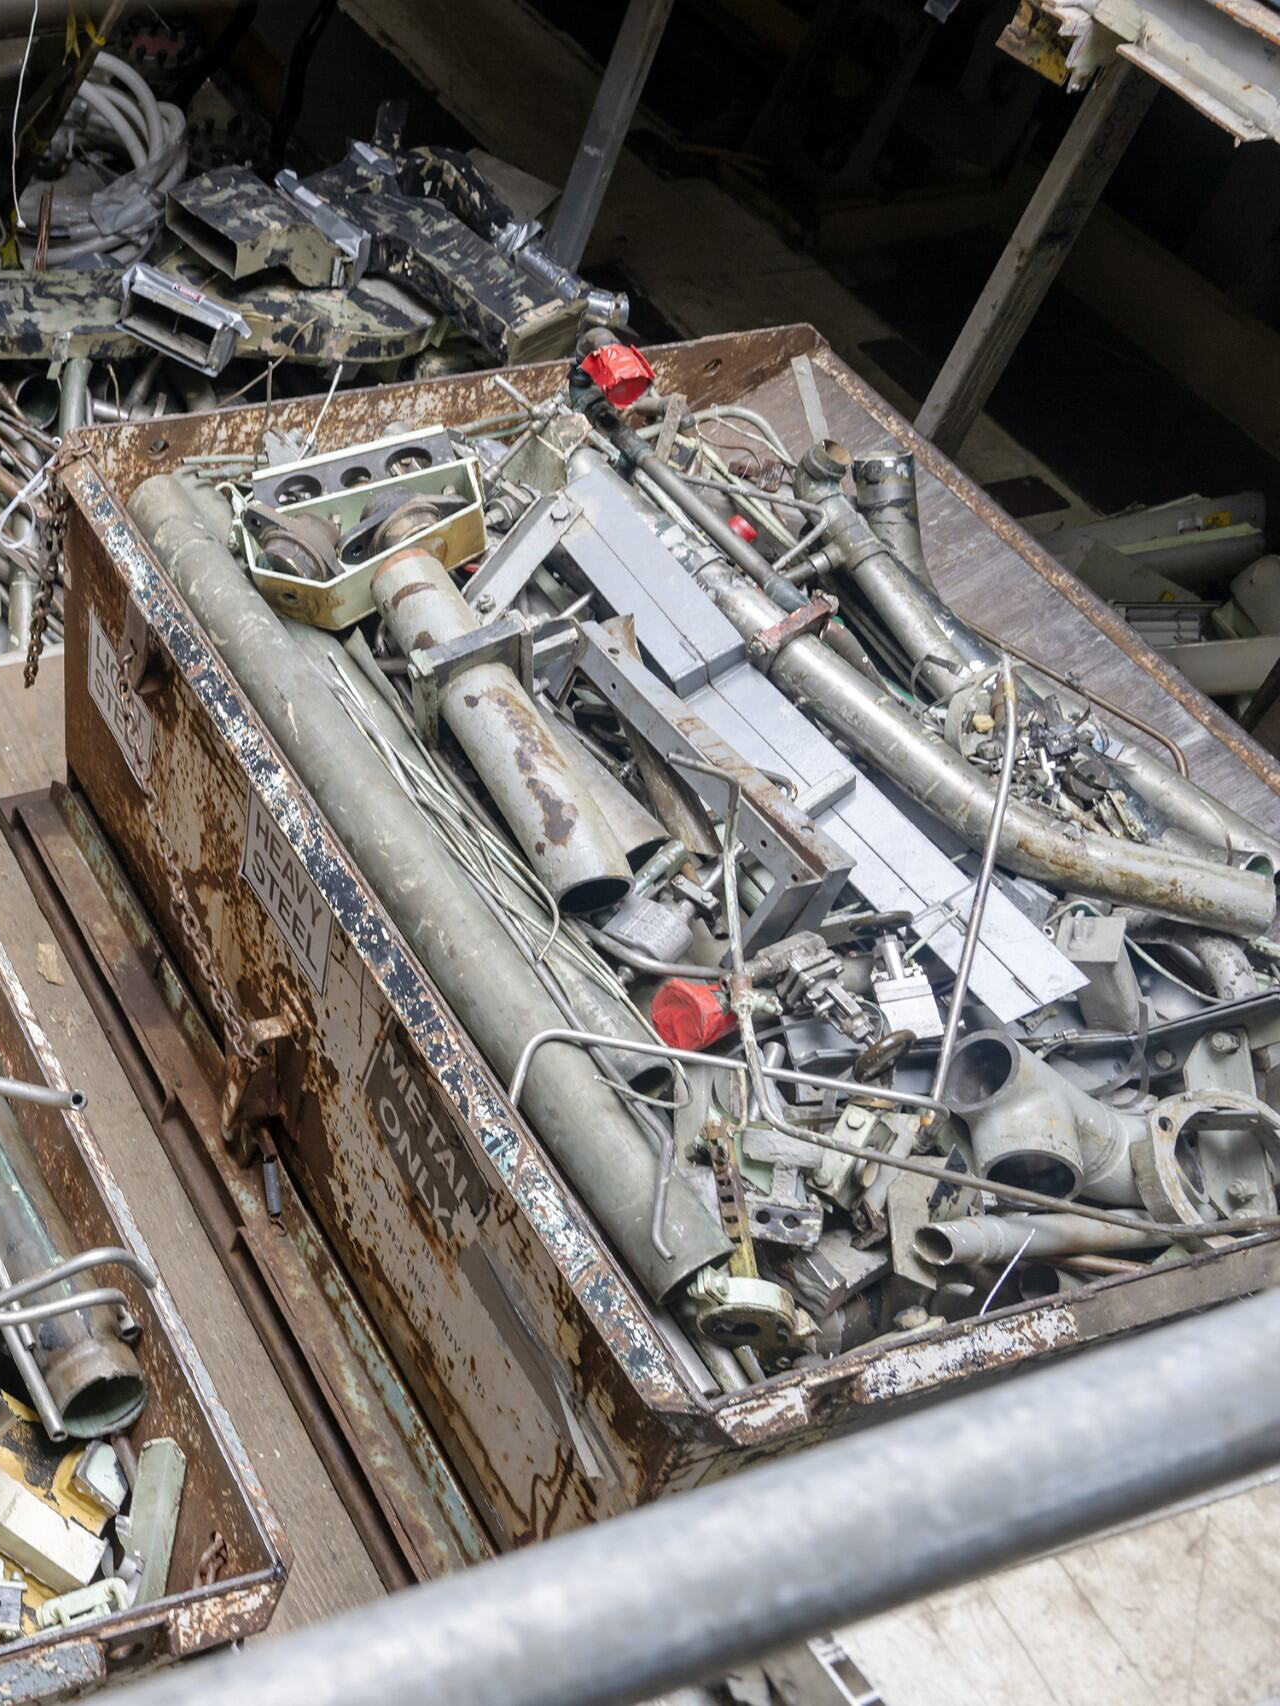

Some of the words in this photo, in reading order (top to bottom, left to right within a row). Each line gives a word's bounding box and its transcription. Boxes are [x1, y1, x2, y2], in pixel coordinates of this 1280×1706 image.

[95, 667, 144, 774] STE
[96, 635, 146, 732] LIGT
[252, 849, 317, 973] STEEL
[256, 811, 323, 928] HEAVY
[380, 1097, 451, 1218] ONLY
[382, 1039, 468, 1205] METAL
